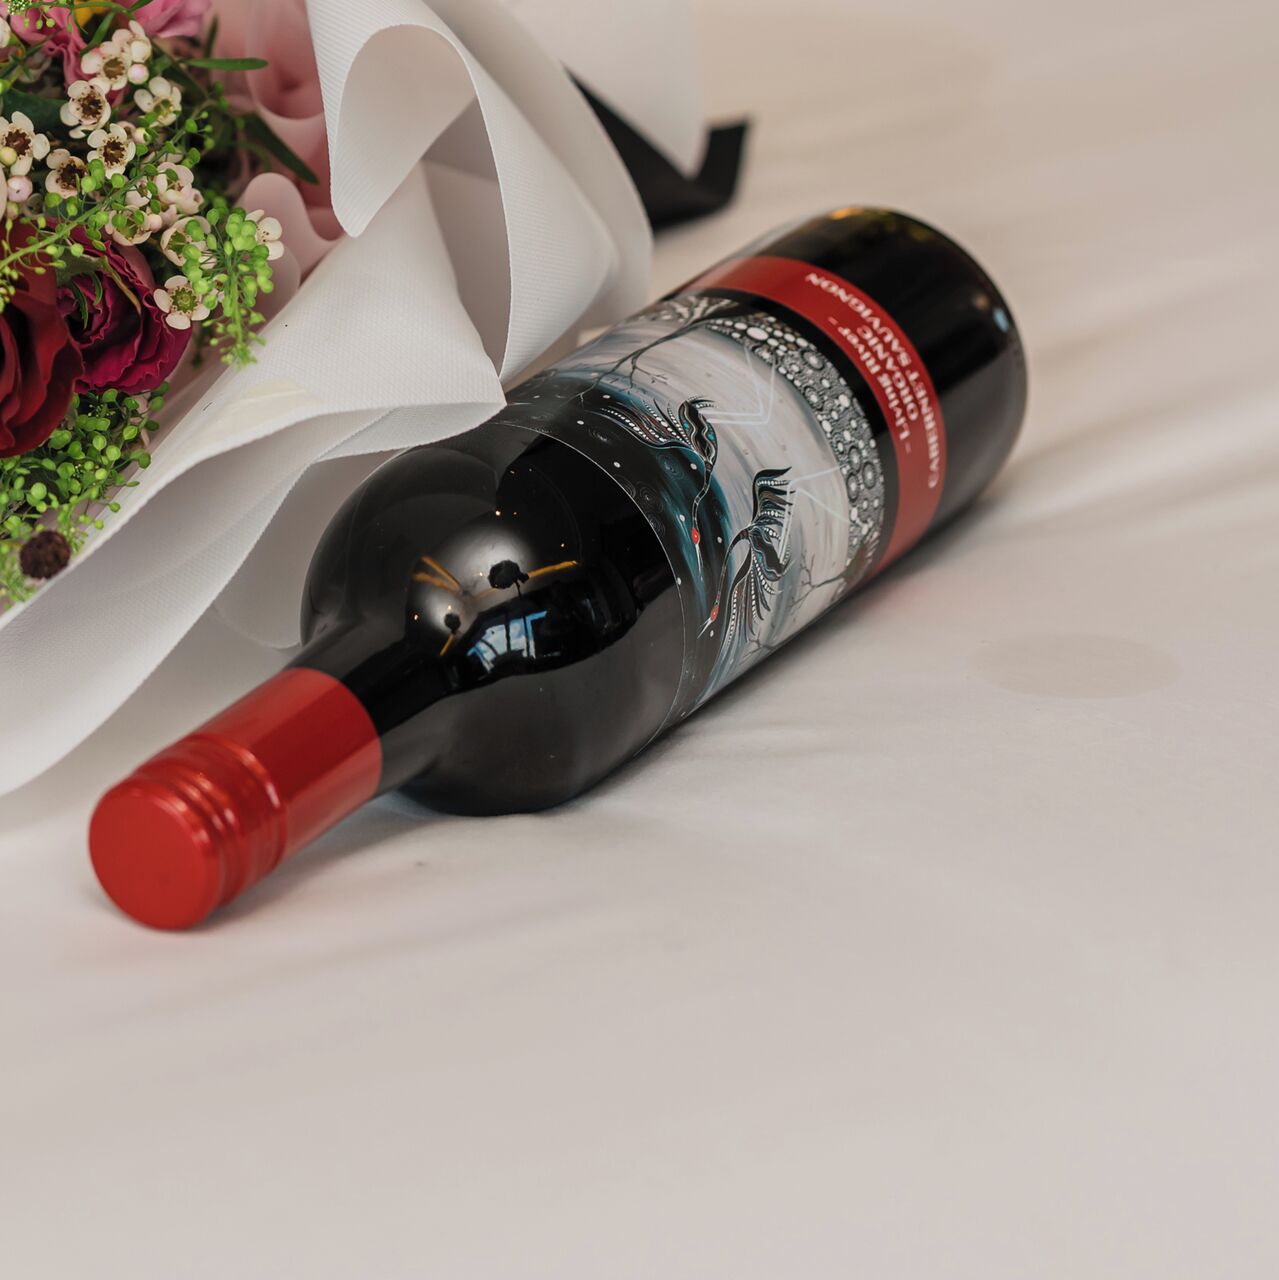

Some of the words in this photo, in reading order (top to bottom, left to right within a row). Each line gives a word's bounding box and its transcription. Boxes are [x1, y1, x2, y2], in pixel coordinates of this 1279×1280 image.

[805, 273, 911, 367] SAUVIGNON
[838, 327, 881, 374] River
[856, 325, 919, 421] ORGANIC
[877, 373, 910, 440] Living
[906, 370, 940, 488] CABERNET
